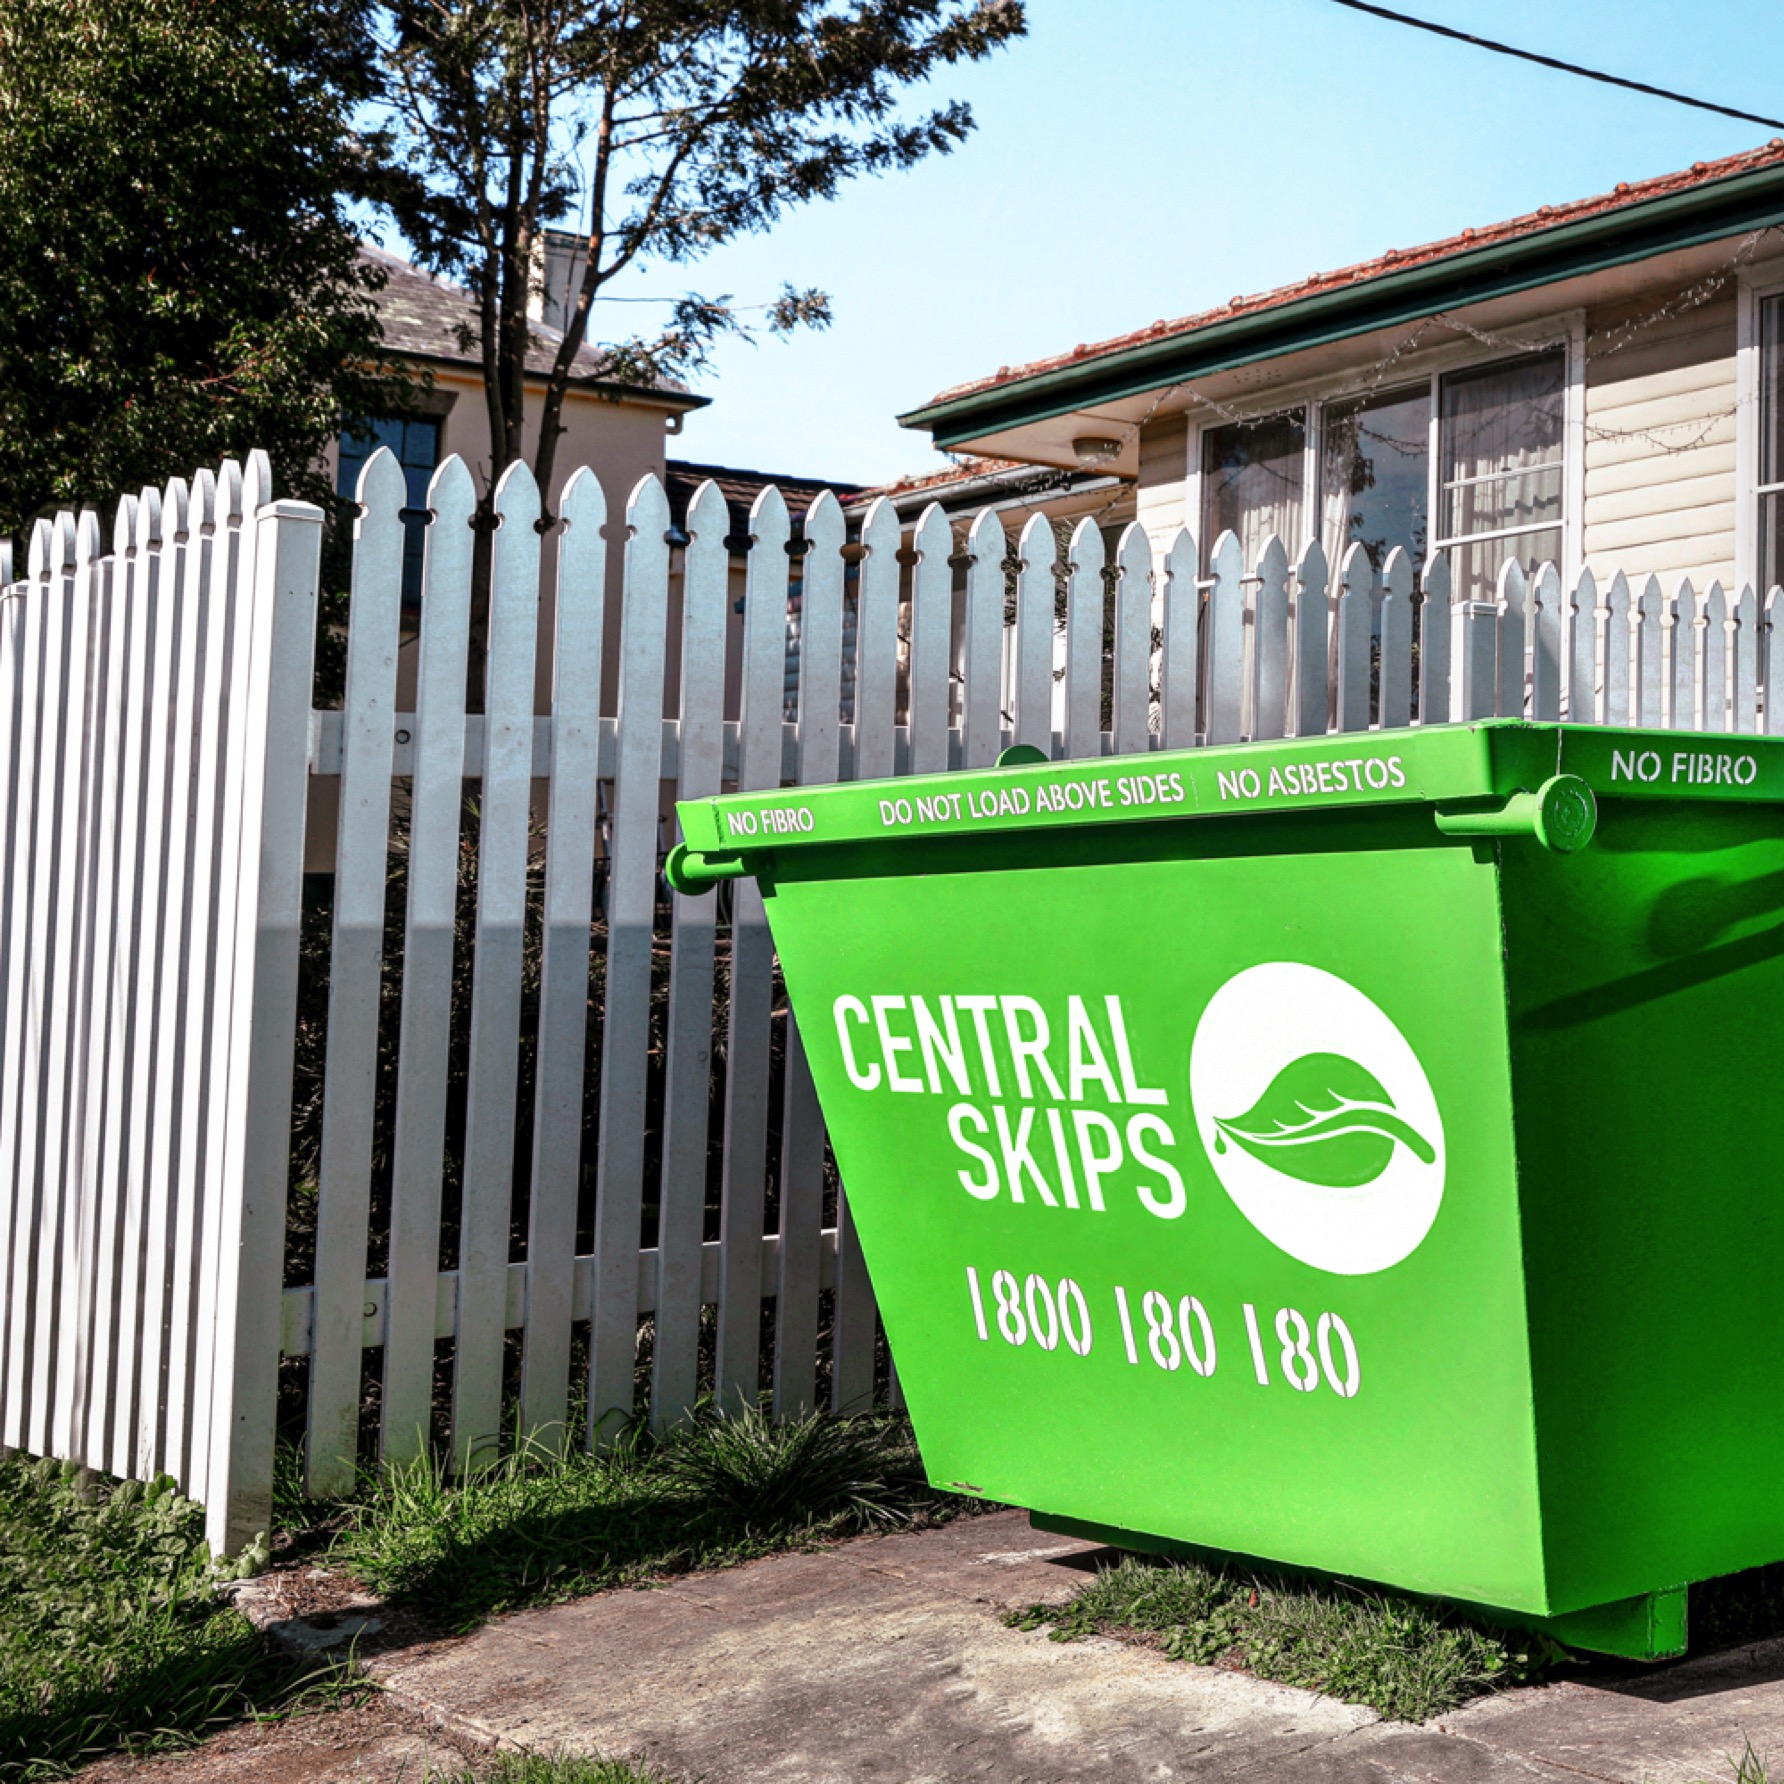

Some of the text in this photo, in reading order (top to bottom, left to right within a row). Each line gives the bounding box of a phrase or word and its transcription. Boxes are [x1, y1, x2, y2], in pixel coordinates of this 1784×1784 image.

[1215, 755, 1406, 801] NO ASBESTOS
[1611, 750, 1757, 785] NO FIBRO
[725, 806, 815, 836] NO FIBRO
[877, 771, 1186, 827] DO NOT LOAD ABOVE SIDES
[832, 994, 1169, 1106] CENTRAL
[947, 1102, 1187, 1220] SKIPS
[966, 1266, 1361, 1398] 1800 180 180
